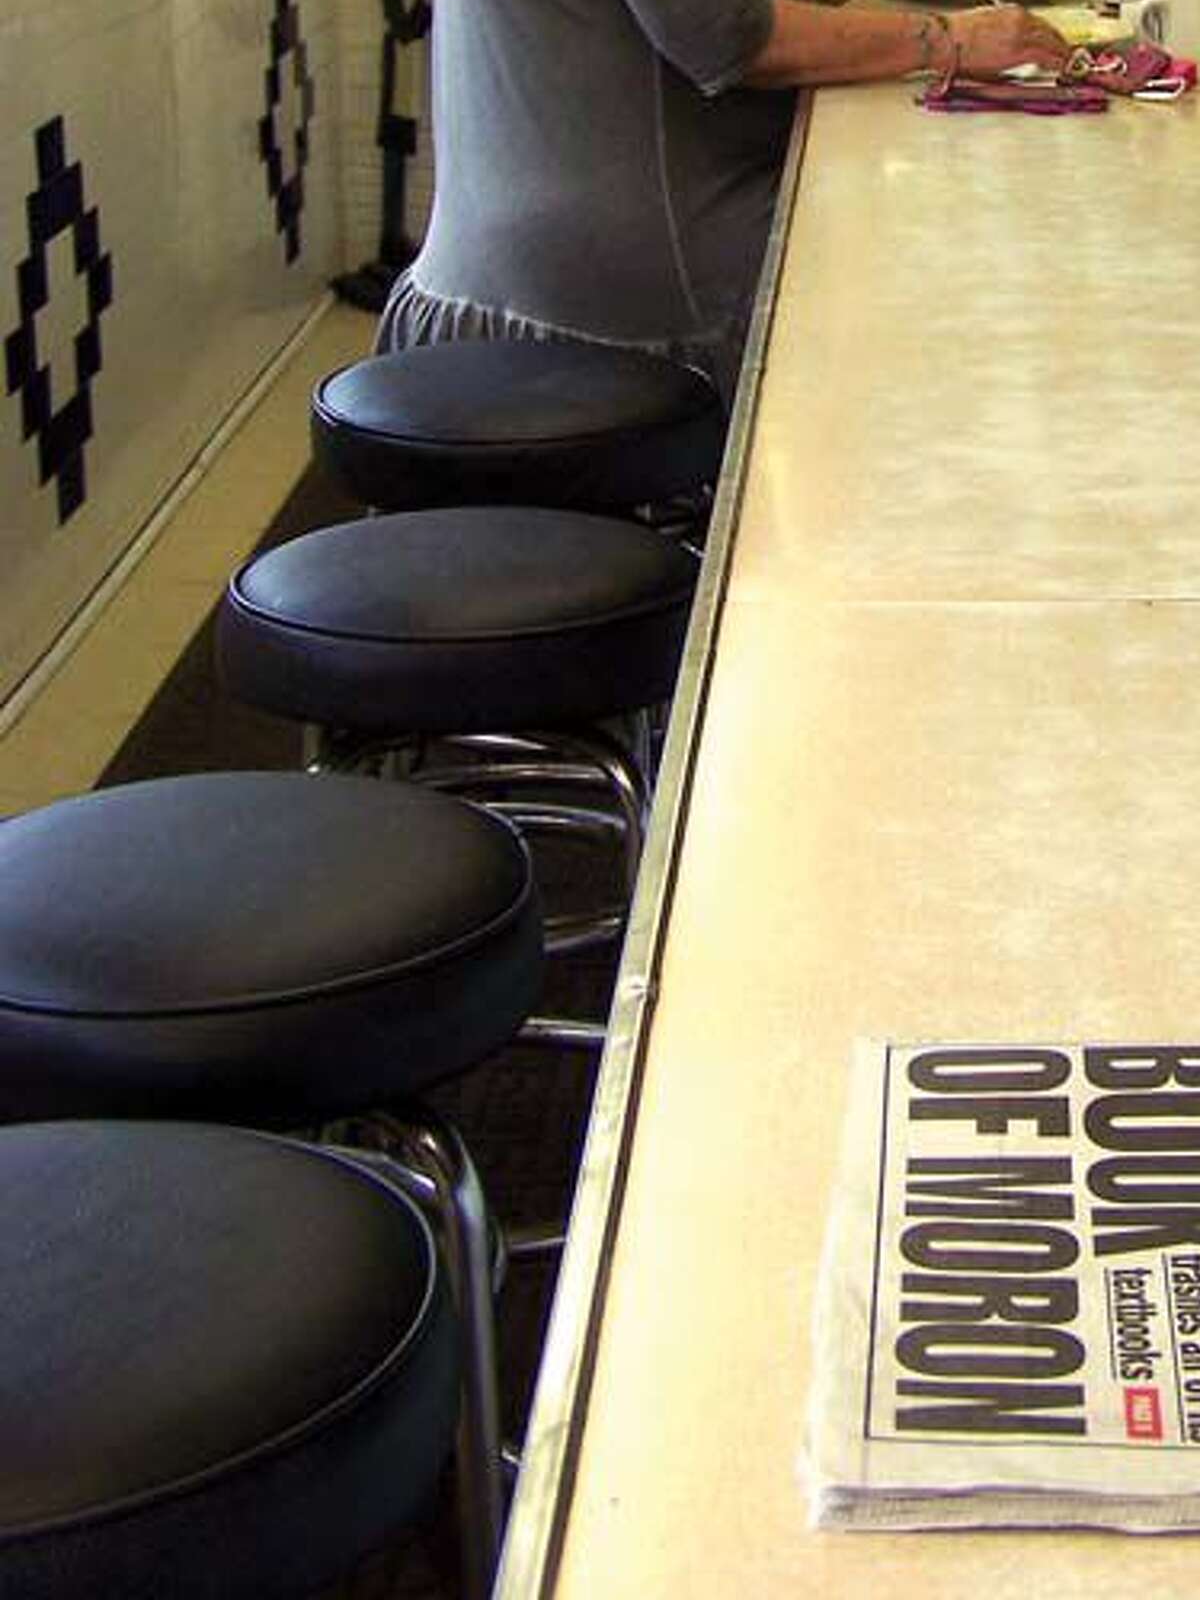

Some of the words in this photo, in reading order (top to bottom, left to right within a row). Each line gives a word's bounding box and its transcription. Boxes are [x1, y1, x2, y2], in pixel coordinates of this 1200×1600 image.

[907, 1049, 1072, 1138] OF
[895, 1156, 1087, 1436] MORON
[1112, 1268, 1162, 1381] textbooks
